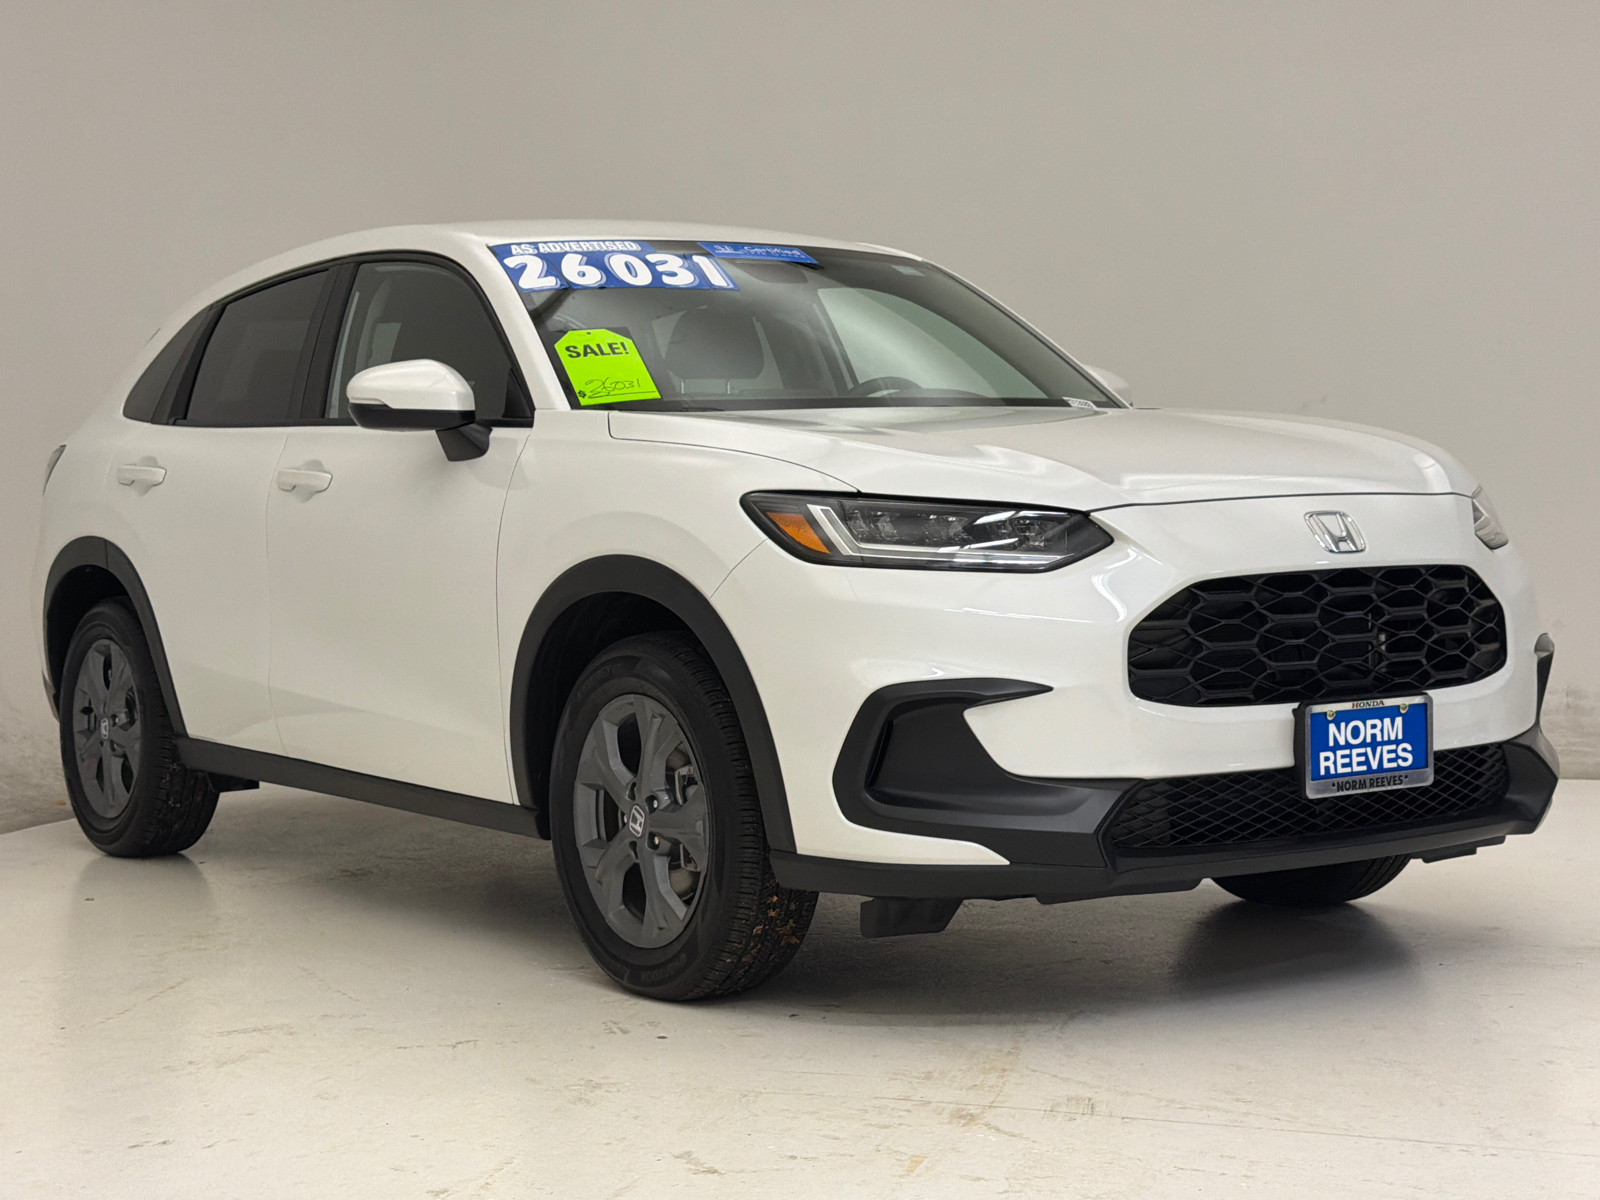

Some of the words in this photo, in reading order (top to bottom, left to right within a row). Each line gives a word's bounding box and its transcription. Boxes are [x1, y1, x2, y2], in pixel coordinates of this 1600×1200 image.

[511, 243, 537, 255] AS
[538, 241, 642, 254] ADVERTISED
[503, 252, 734, 290] 26031
[565, 342, 630, 359] SALE!
[585, 377, 641, 395] 26031
[1351, 700, 1385, 709] HONDA
[1328, 716, 1403, 747] NORM
[1319, 743, 1414, 776] REEVES
[1336, 779, 1368, 792] NORM
[1369, 775, 1404, 789] REEVES
